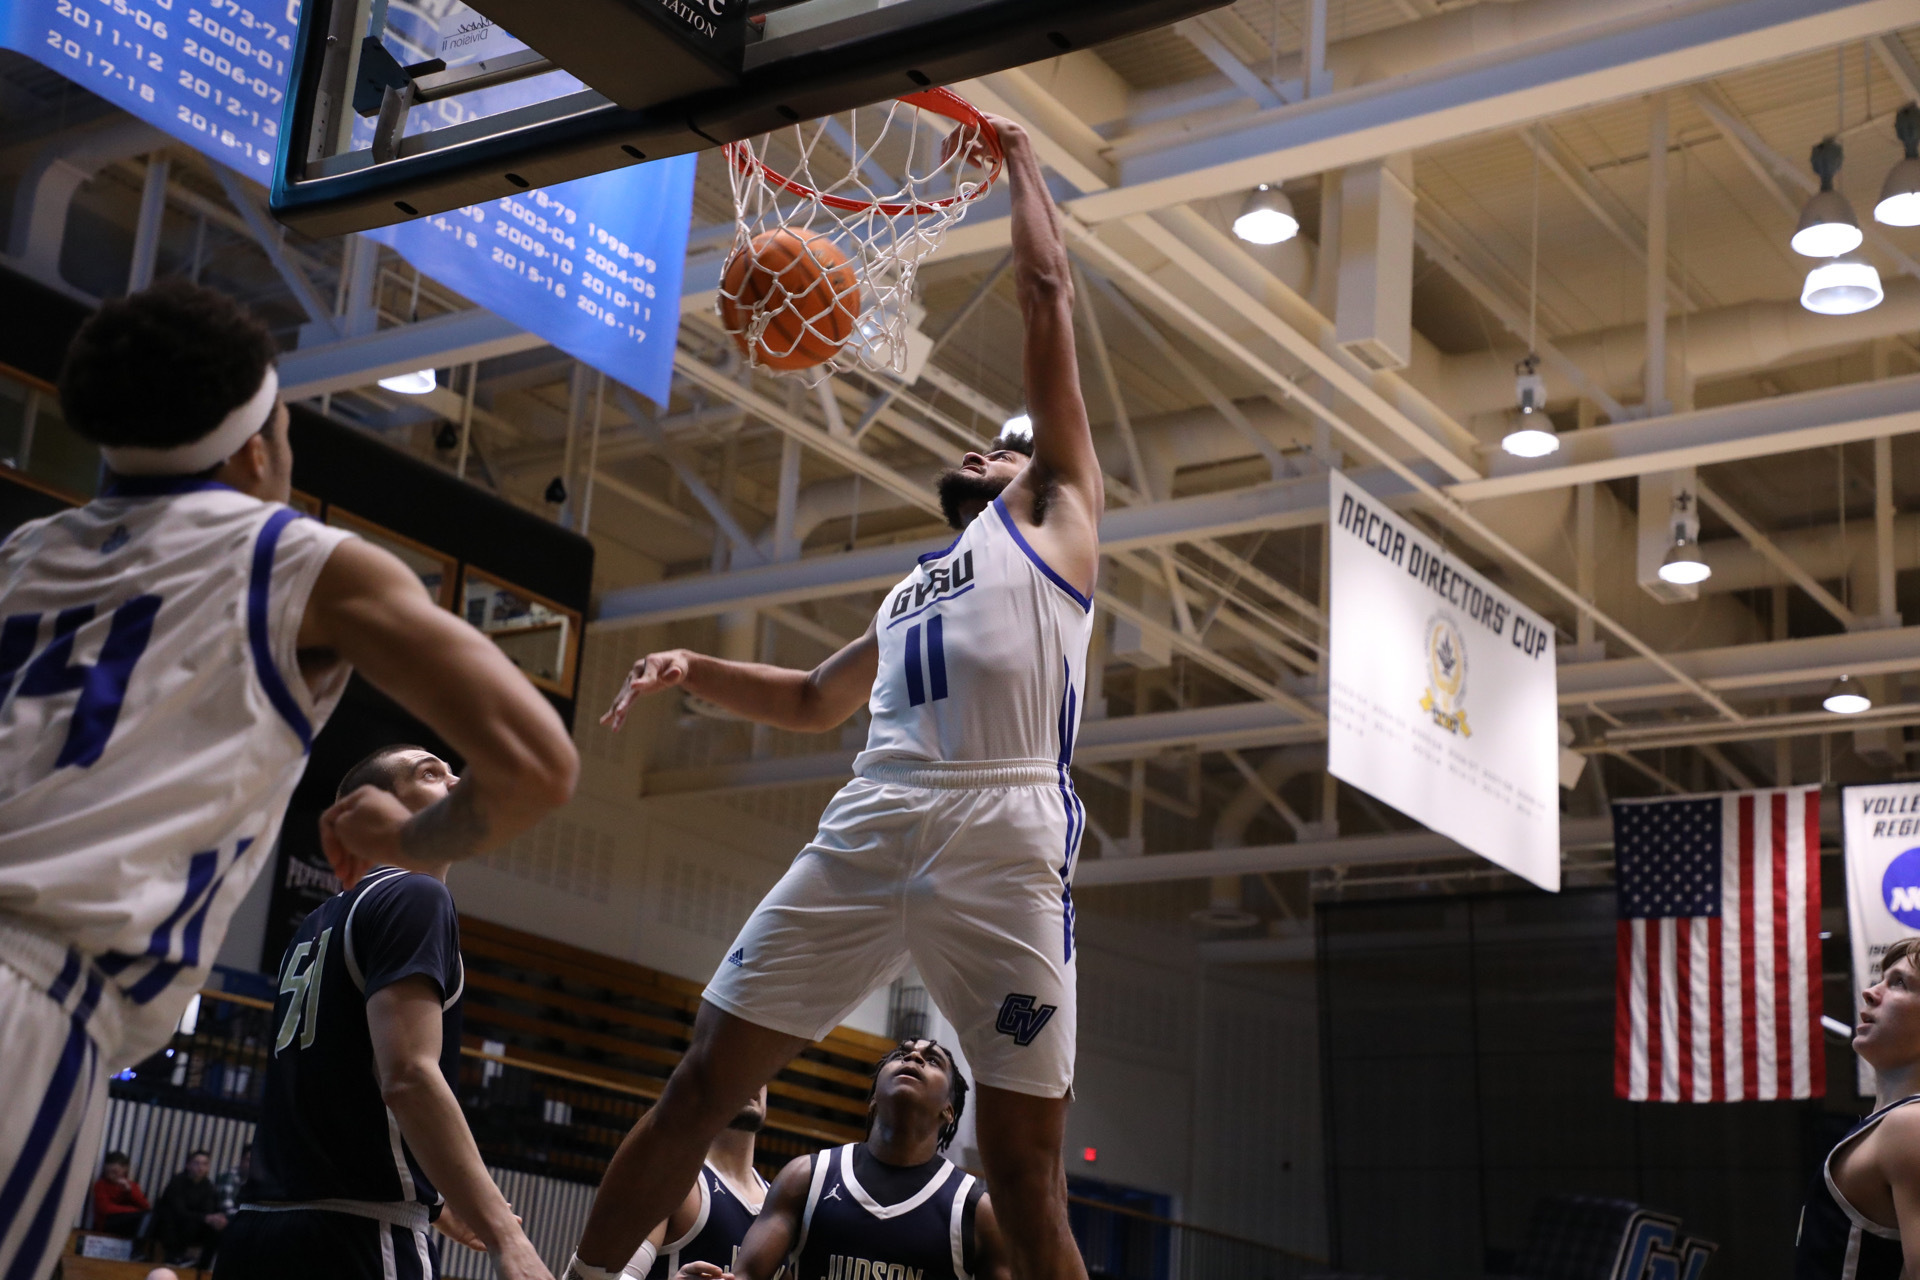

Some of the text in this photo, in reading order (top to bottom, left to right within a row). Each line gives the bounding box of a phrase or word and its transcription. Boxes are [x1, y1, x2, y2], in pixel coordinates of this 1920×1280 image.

[46, 29, 156, 103] 2017-18
[56, 0, 277, 137] 2011-12 2012-13
[183, 37, 283, 104] 2006-07
[187, 8, 284, 76] 2000-01
[491, 246, 566, 299] 2015-16
[577, 294, 646, 344] 2016-17
[495, 220, 651, 322] 2009-10 2010-11
[499, 196, 656, 299] 2003-04 2004-05
[588, 222, 656, 274] 1998-99
[1338, 493, 1405, 567] NACDA
[1511, 614, 1548, 661] CUP
[0, 594, 163, 769] 4
[904, 613, 949, 708] 11
[274, 927, 333, 1059] 51
[996, 993, 1057, 1047] GV
